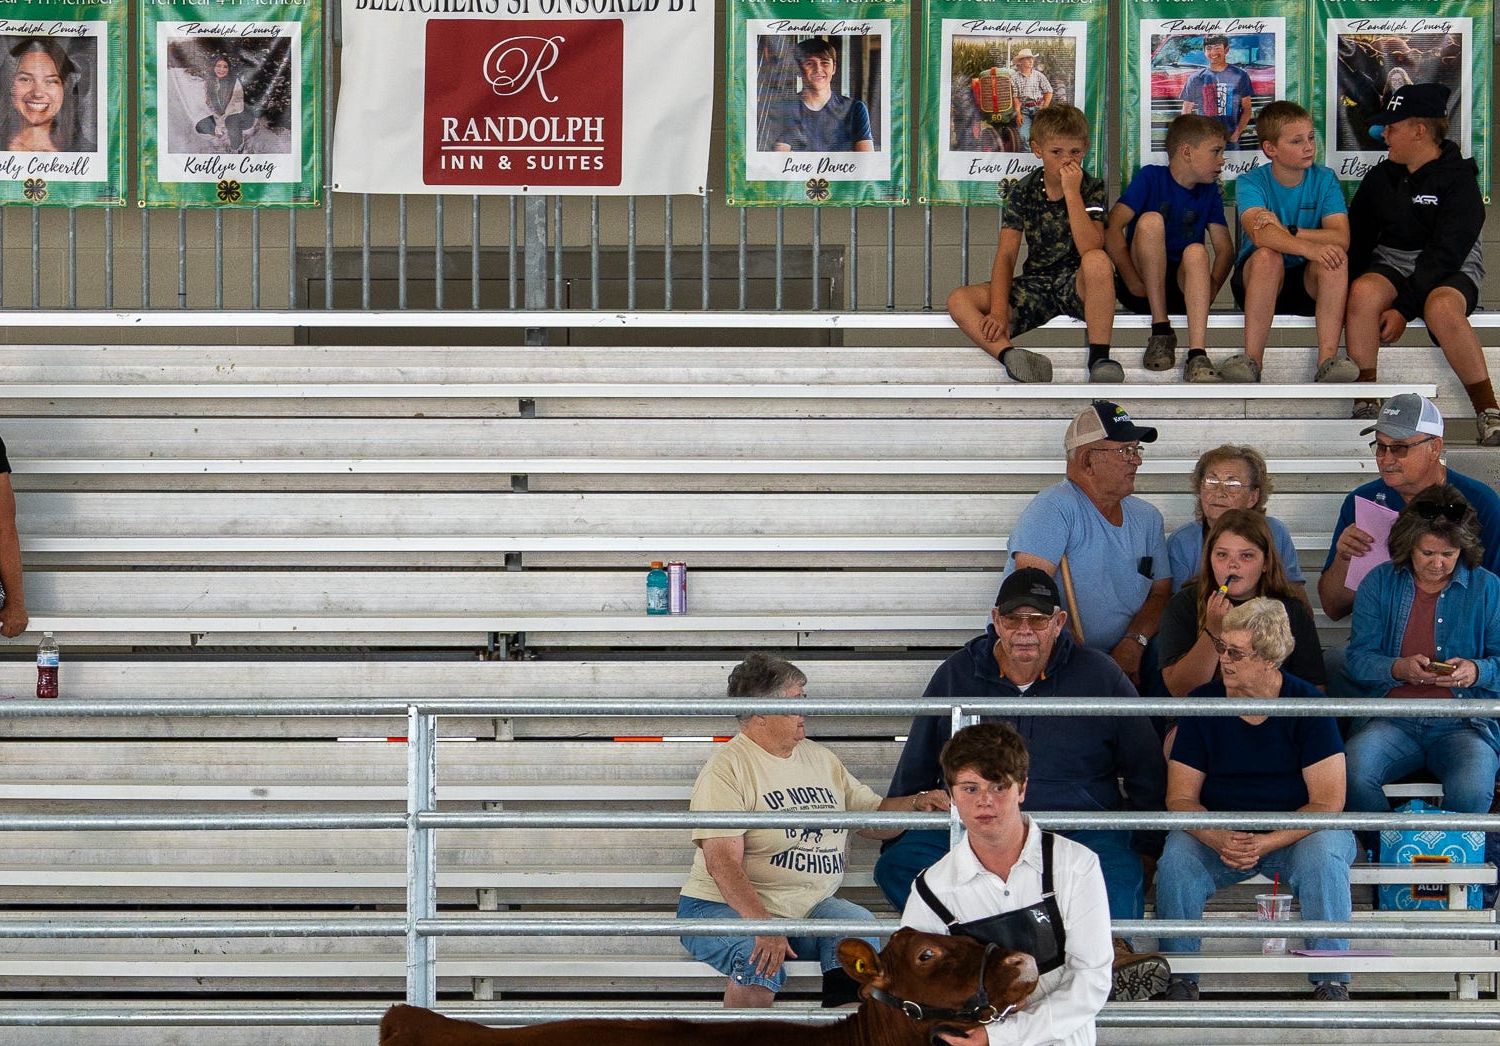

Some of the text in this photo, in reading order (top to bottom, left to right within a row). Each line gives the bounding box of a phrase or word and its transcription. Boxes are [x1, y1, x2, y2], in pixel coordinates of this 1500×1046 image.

[48, 21, 90, 36] County
[177, 22, 283, 37] Randolph County
[767, 20, 873, 35] Randolph County
[962, 19, 1069, 36] Randolph County
[1160, 18, 1268, 33] Randolph County
[1347, 19, 1453, 34] Randolph County
[482, 35, 566, 104] R
[441, 117, 605, 143] RANDOLPH
[27, 156, 90, 176] Cockerill
[184, 155, 277, 180] Kaitlyn Craig
[441, 155, 605, 172] INN & SUITES
[782, 157, 857, 175] Lane Dance
[968, 158, 1002, 175] Evan
[763, 786, 838, 811] UP NORTH
